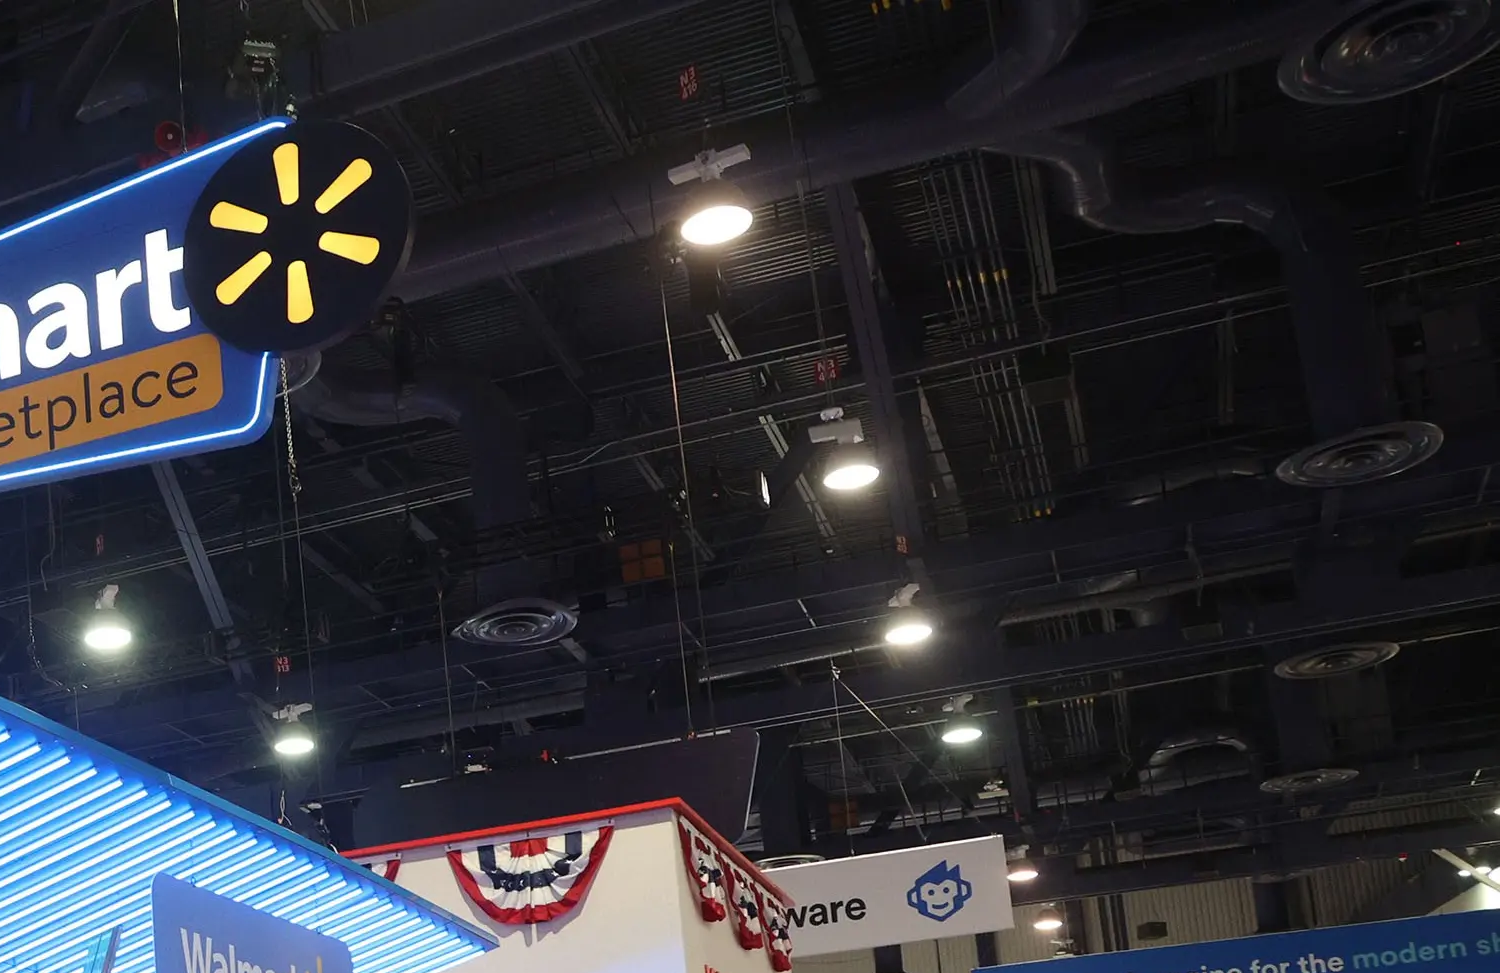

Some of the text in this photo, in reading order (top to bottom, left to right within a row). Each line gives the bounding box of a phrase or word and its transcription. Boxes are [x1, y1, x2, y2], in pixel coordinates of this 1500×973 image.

[680, 66, 695, 87] N3
[787, 898, 866, 928] ware
[1353, 939, 1467, 970] modern
